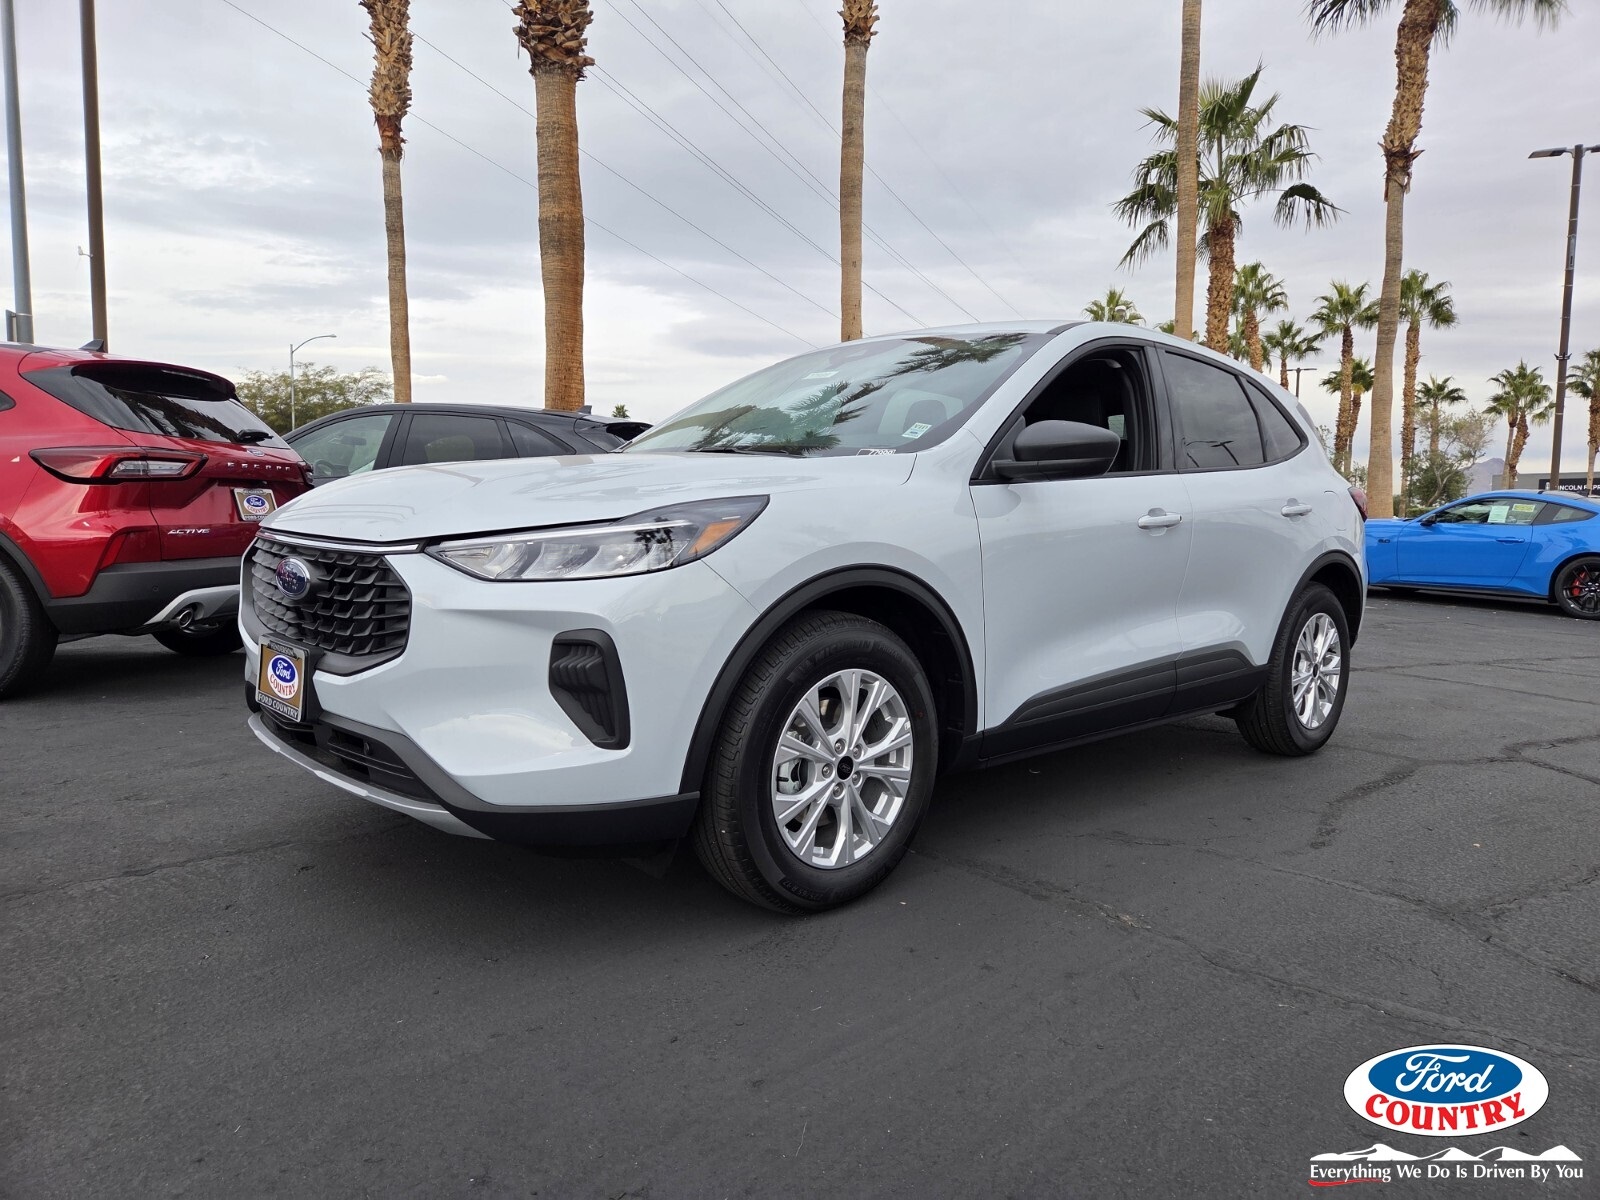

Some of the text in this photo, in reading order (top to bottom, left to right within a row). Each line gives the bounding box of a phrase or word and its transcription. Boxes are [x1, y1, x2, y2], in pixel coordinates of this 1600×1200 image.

[227, 462, 290, 470] ESCAPE
[275, 660, 292, 680] Ford
[270, 673, 296, 697] COUNTRY
[258, 693, 298, 718] FORD COUNTRY
